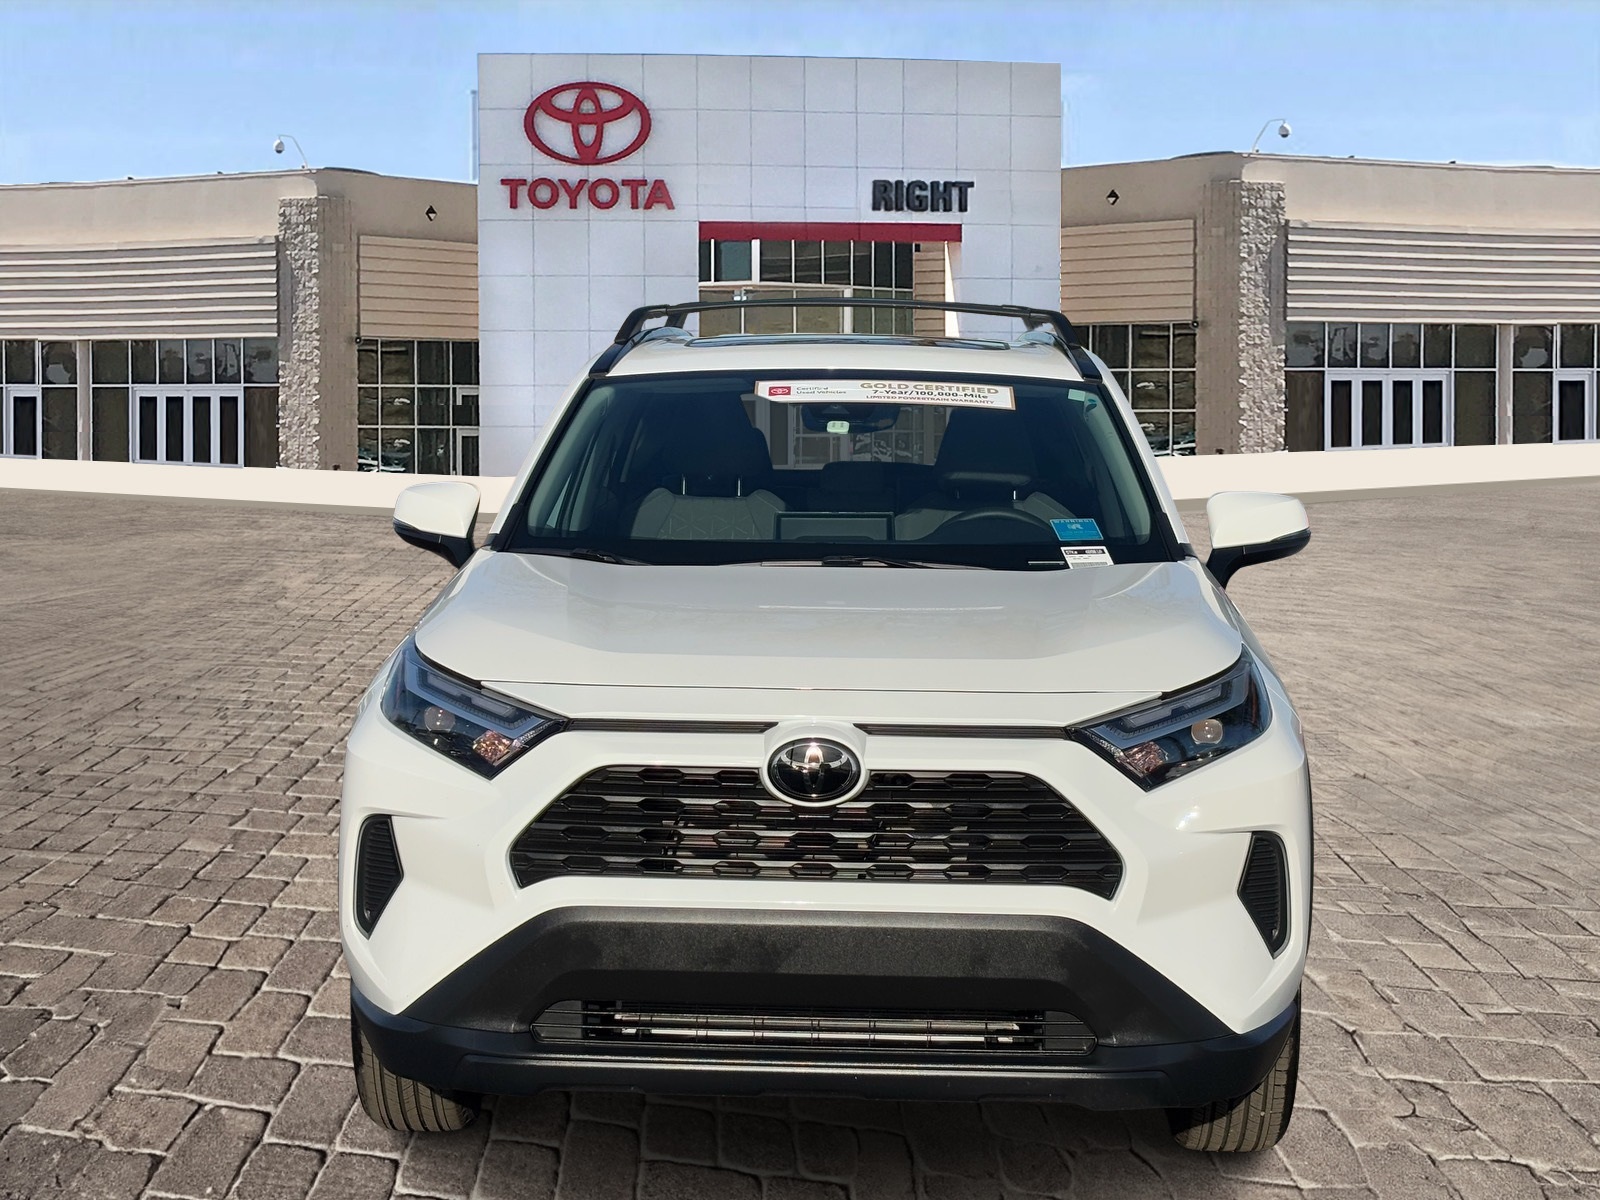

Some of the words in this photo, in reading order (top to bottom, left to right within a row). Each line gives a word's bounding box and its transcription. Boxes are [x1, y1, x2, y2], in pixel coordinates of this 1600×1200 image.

[500, 178, 675, 210] TOYOTA
[871, 179, 976, 212] RIGHT
[860, 382, 909, 390] GOLD
[913, 384, 999, 395] CERTIFIED
[872, 390, 989, 399] 7-Year/100,000-Mile
